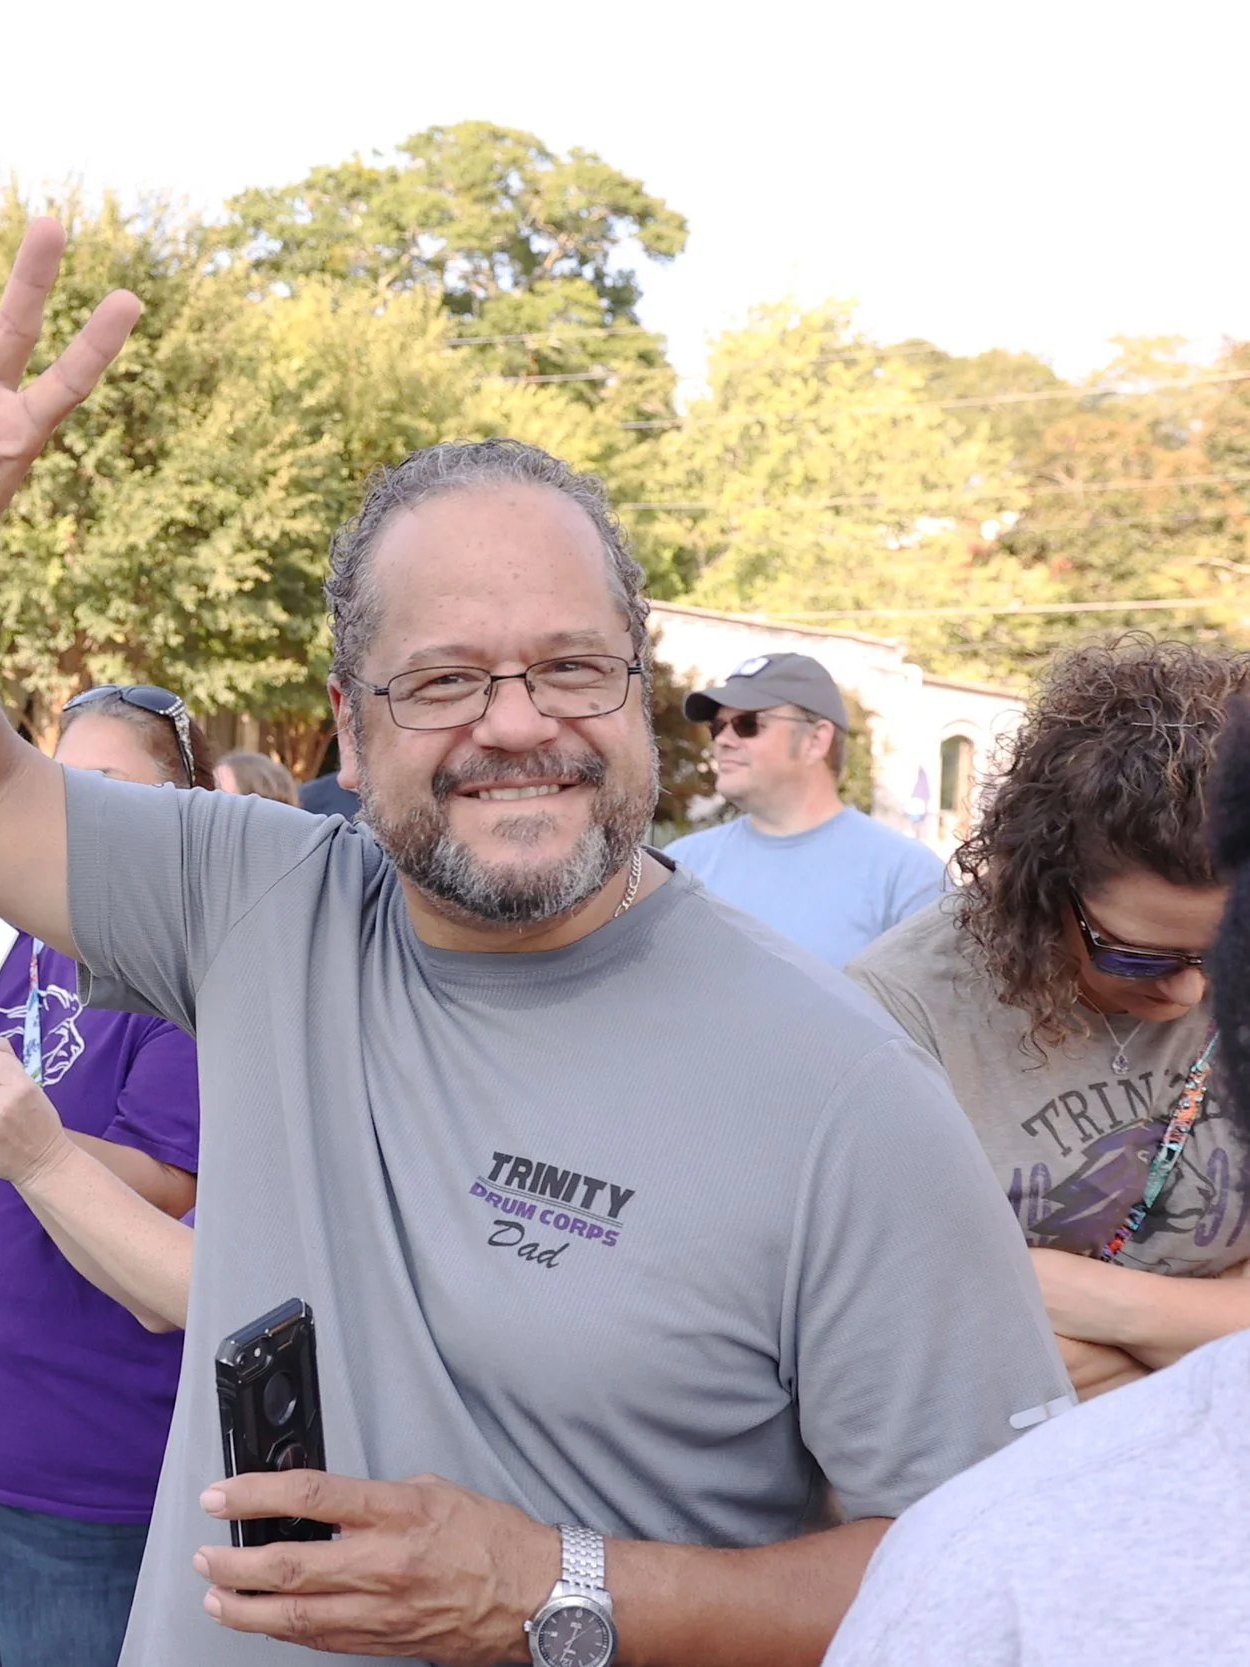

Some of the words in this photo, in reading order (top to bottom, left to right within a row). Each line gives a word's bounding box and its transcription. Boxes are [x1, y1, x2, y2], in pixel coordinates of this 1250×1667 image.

[469, 1181, 537, 1220] DRUM
[539, 1209, 621, 1247] CORPS
[487, 1151, 636, 1219] TRINITY
[487, 1219, 570, 1269] Dad
